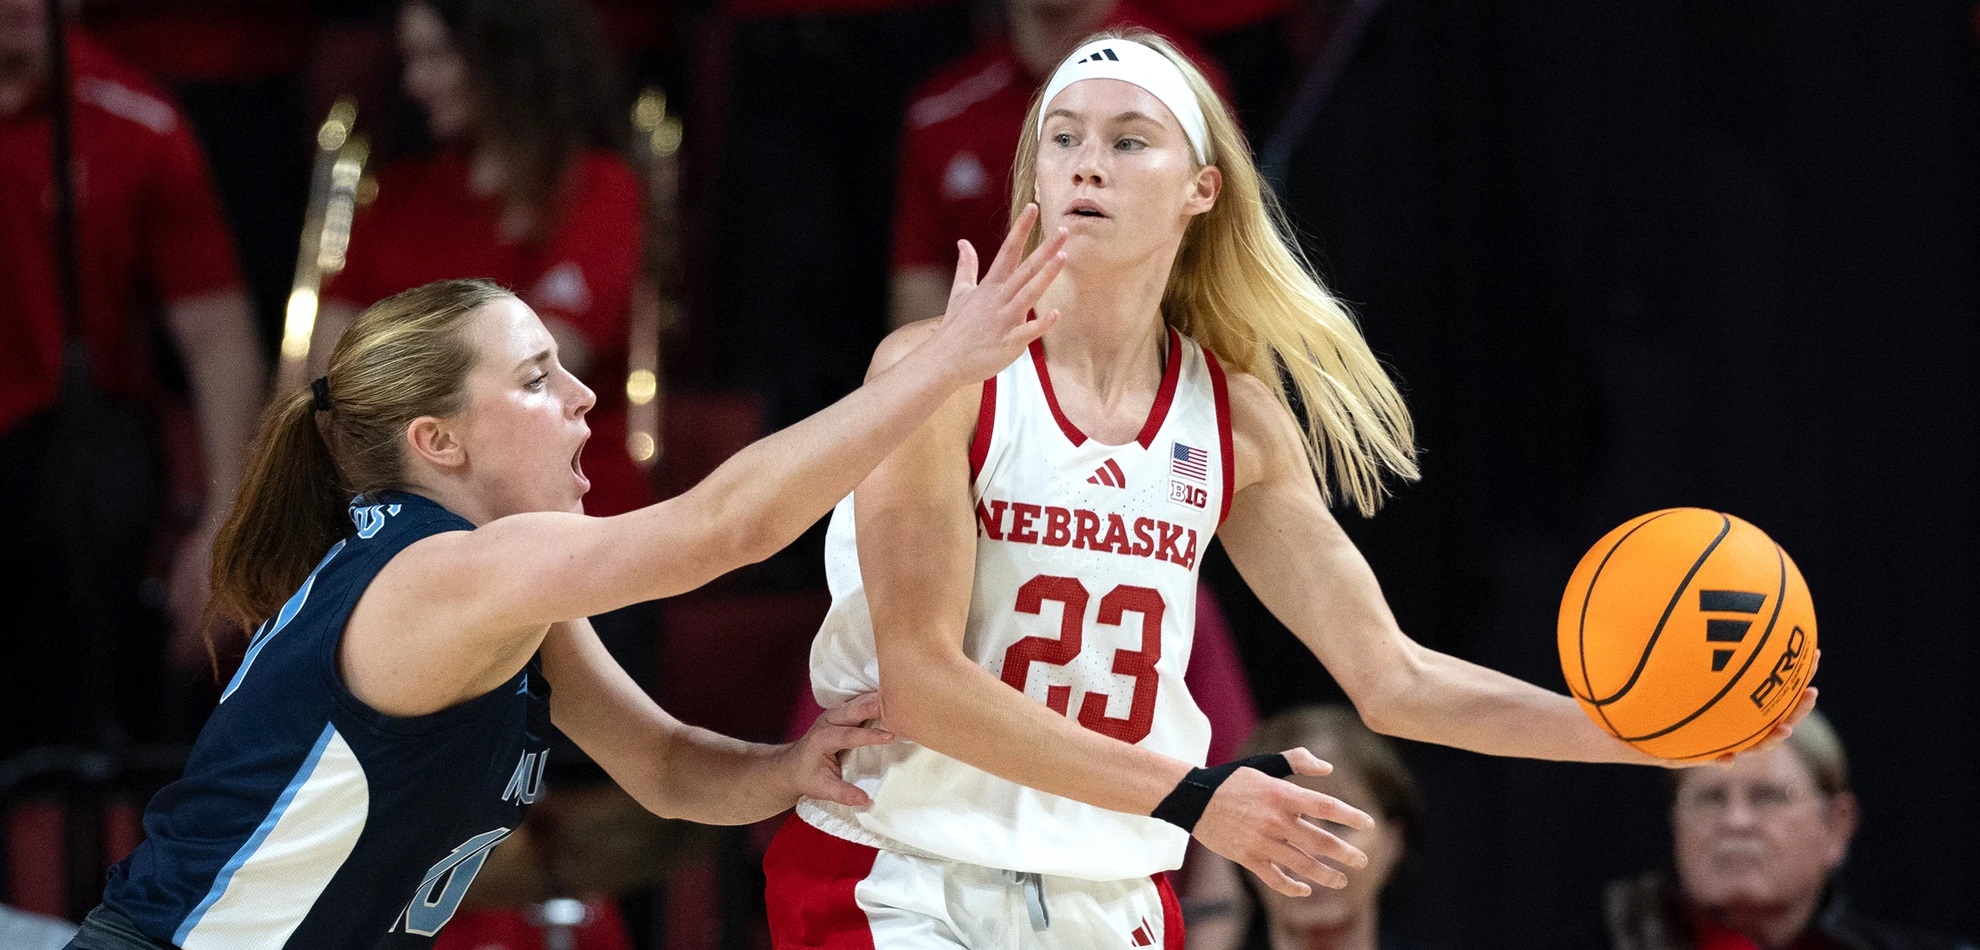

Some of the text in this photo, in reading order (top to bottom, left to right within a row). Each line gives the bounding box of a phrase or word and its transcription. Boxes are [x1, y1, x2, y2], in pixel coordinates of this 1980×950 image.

[977, 497, 1197, 572] NEBRASKA
[1001, 574, 1166, 745] 23
[1750, 625, 1805, 709] PRO
